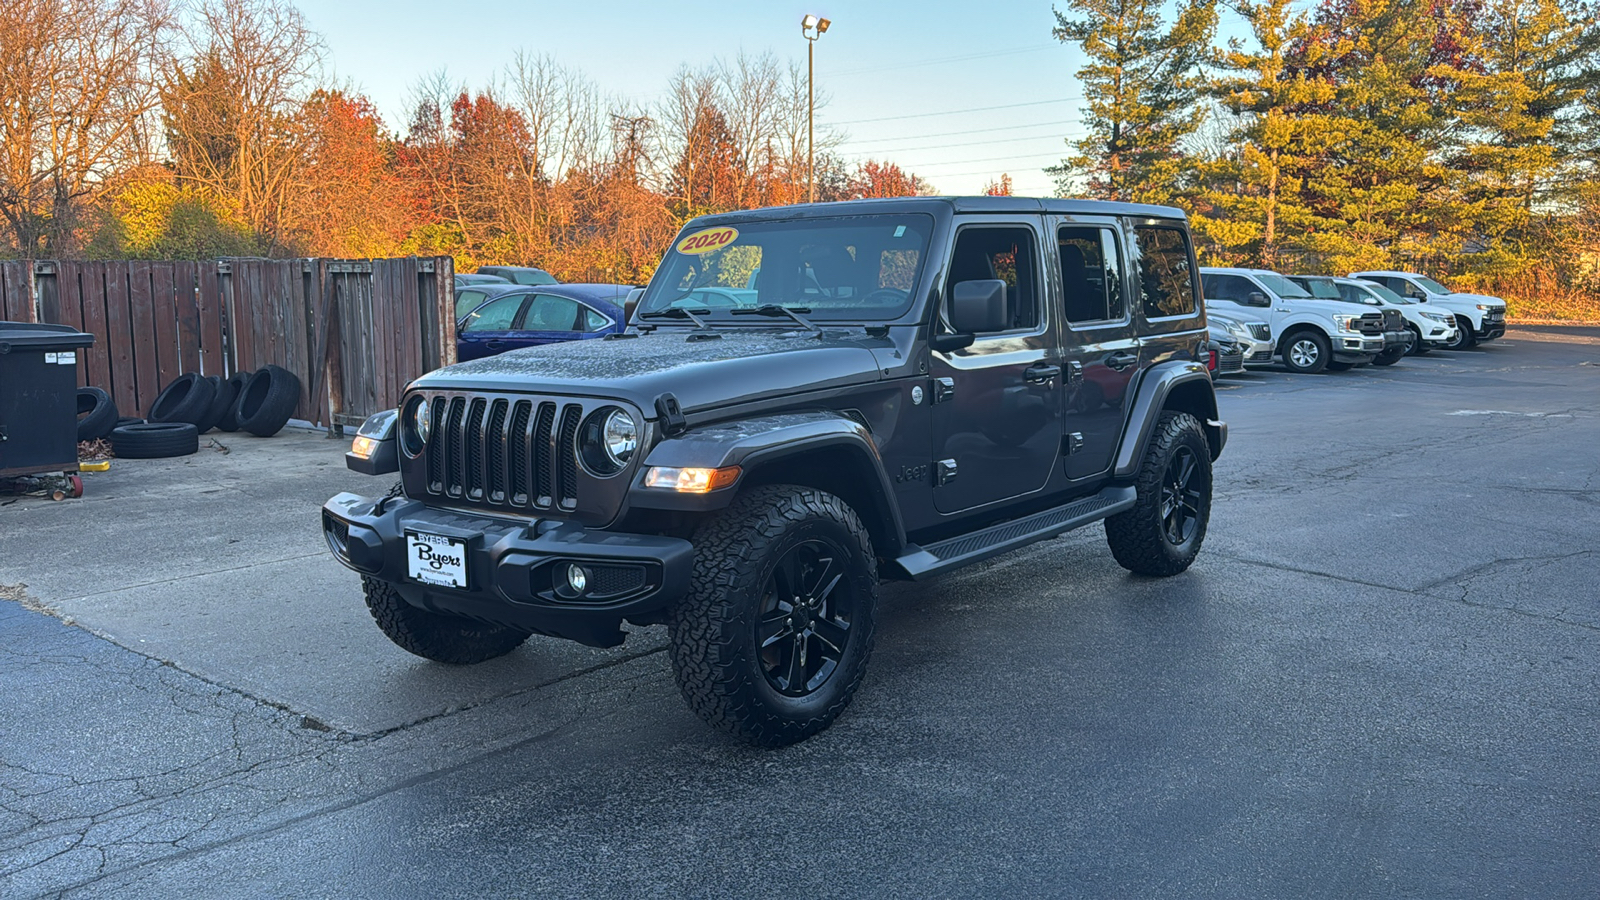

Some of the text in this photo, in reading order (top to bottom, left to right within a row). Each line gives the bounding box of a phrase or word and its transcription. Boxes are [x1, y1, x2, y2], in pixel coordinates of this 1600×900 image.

[681, 230, 733, 251] 2020
[896, 464, 927, 484] Jeep
[419, 533, 450, 546] BYERS
[412, 542, 461, 570] Byers
